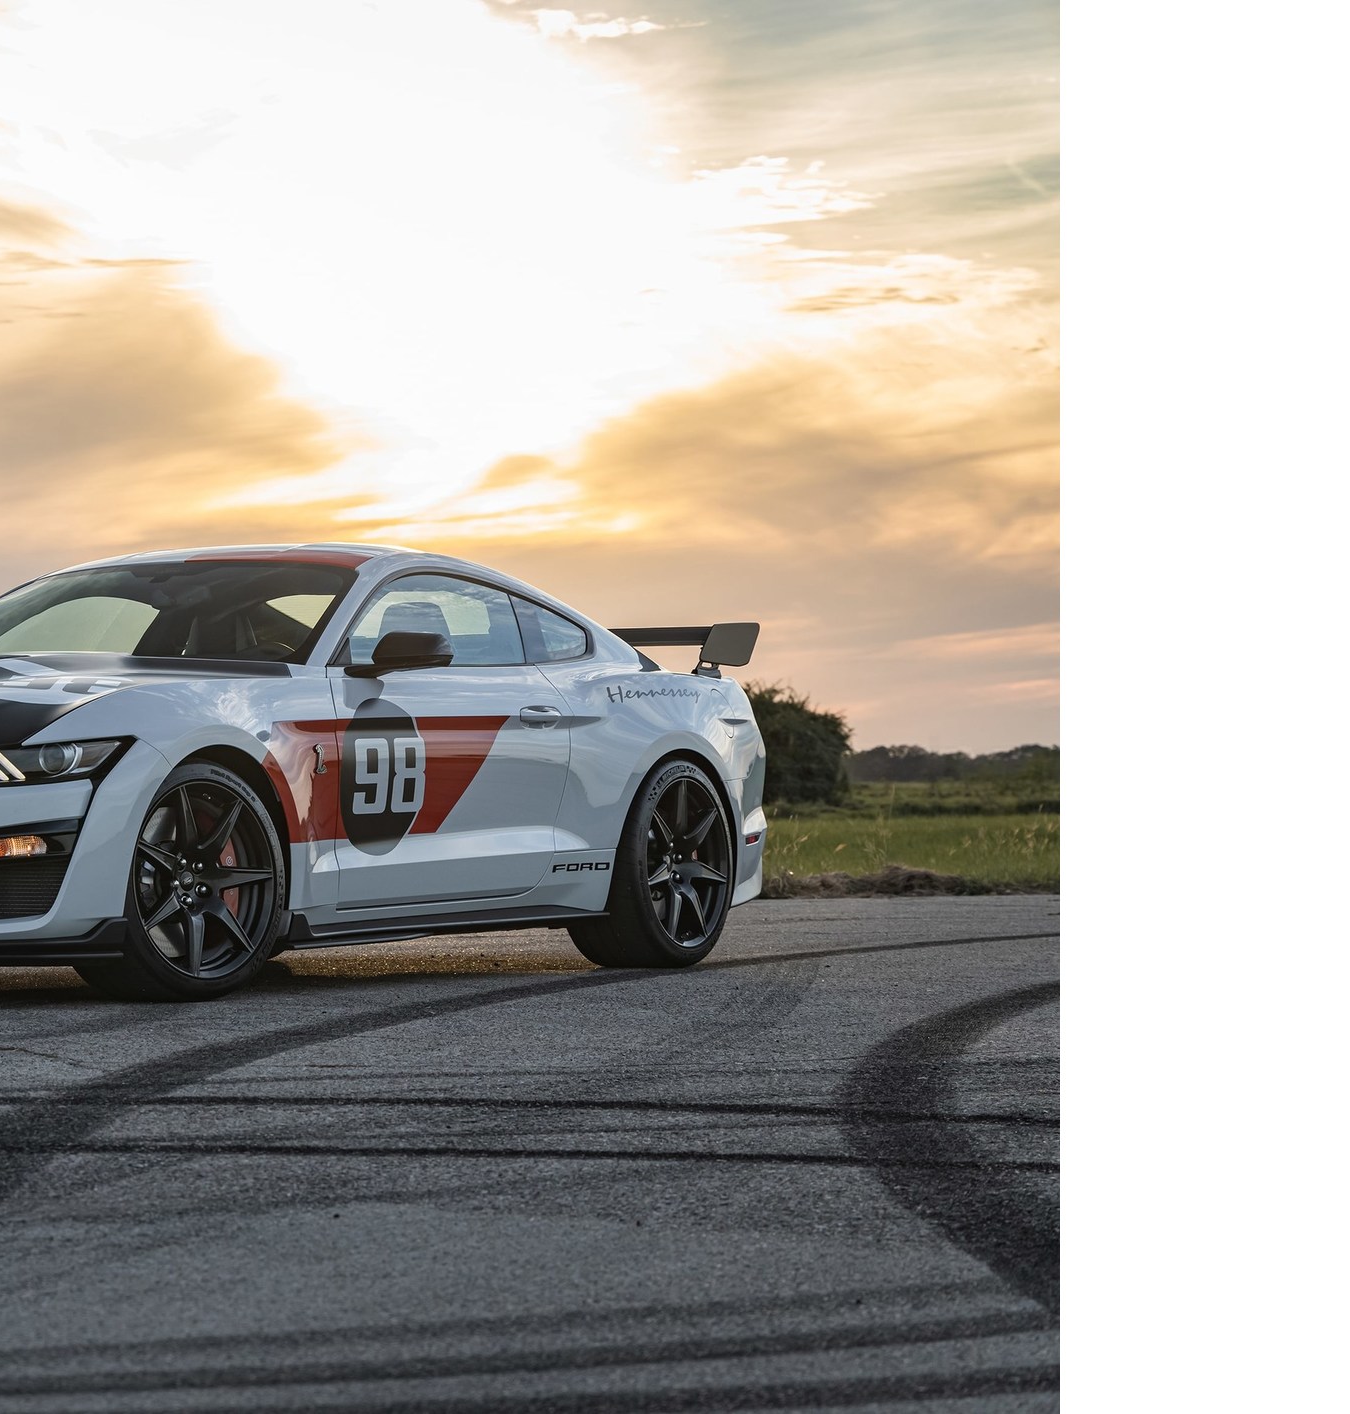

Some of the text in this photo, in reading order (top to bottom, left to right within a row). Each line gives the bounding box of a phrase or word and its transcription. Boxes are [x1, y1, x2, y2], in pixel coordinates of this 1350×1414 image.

[606, 685, 701, 703] Hennessey
[352, 737, 426, 815] 98
[552, 862, 610, 873] FORD
